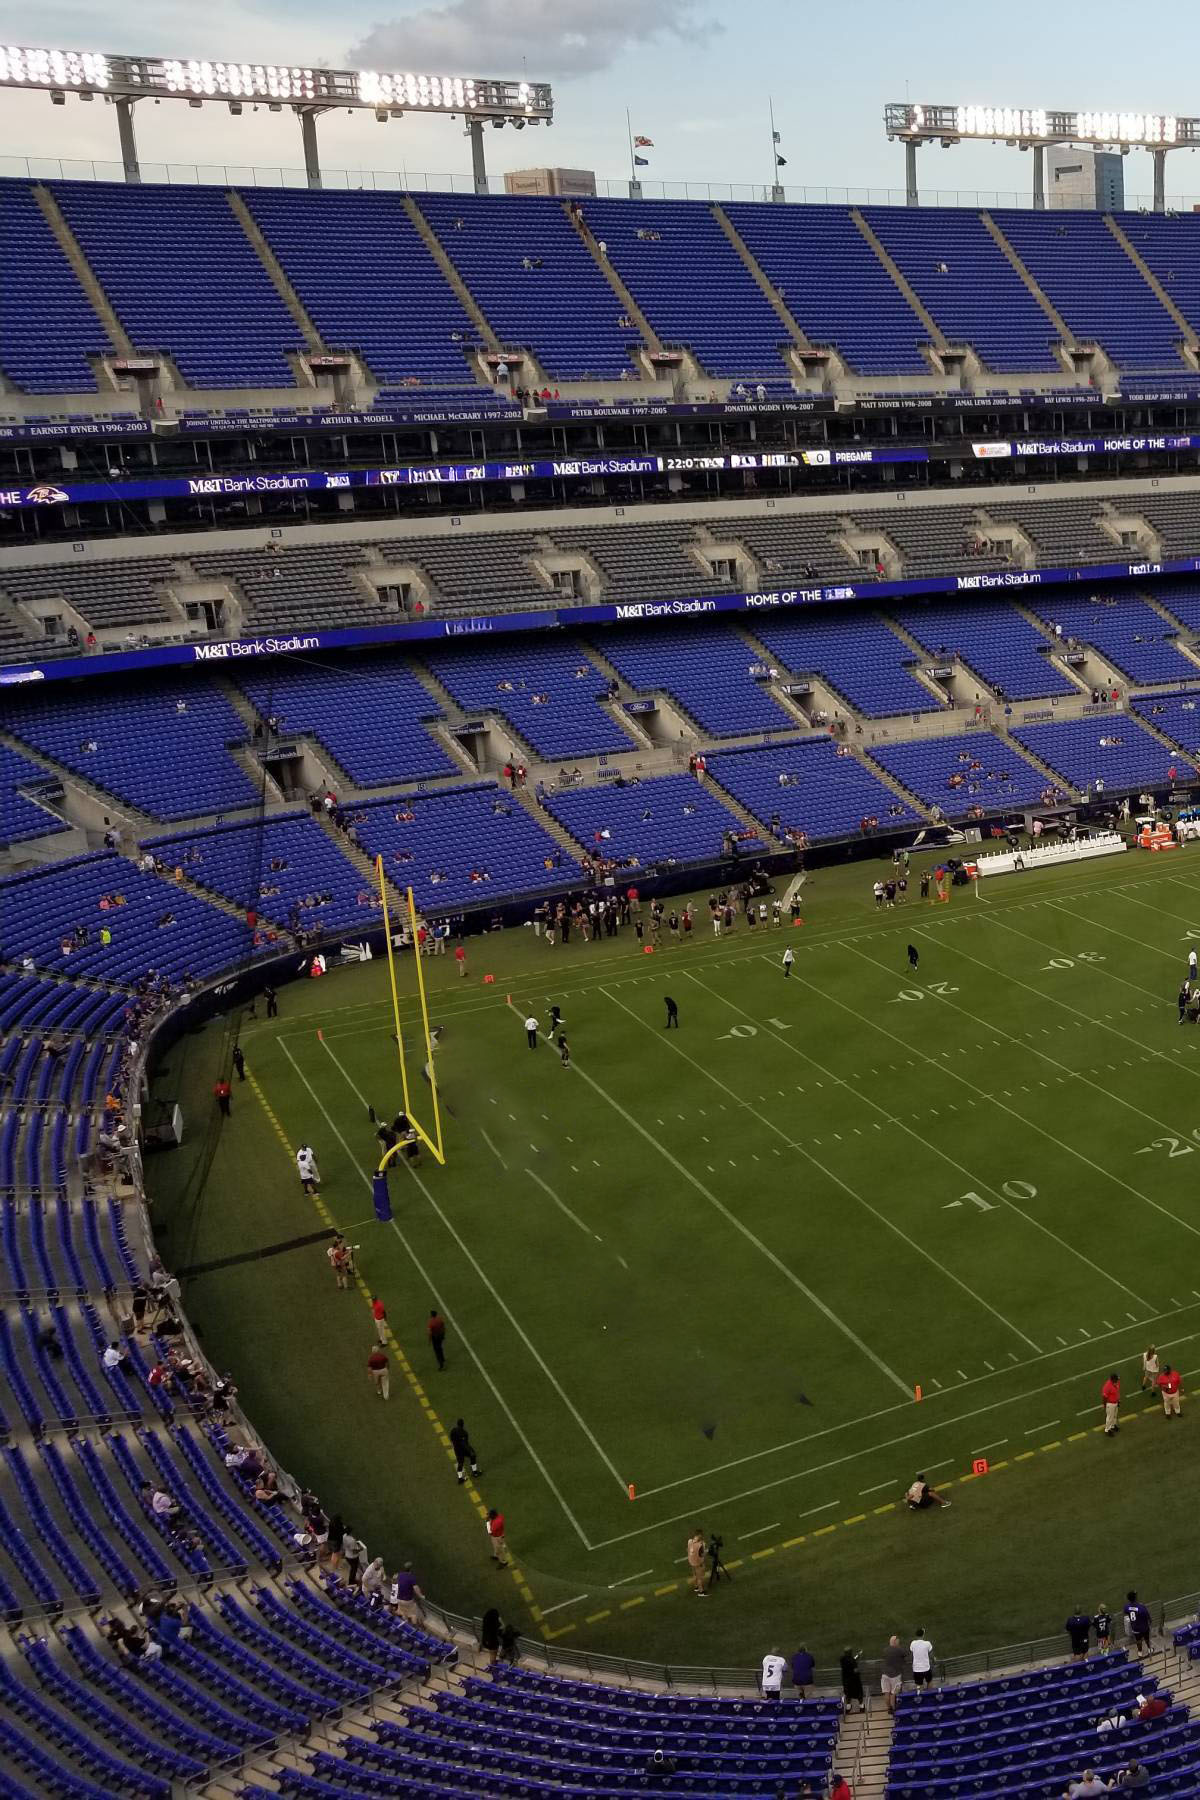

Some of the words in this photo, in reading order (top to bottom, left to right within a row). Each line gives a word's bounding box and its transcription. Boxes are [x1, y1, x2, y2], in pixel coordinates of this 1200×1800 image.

[724, 405, 757, 413] JONATHAN
[758, 404, 780, 412] OGDEN
[782, 403, 814, 411] 1996-2007
[955, 399, 974, 407] JAMAL
[414, 413, 446, 422] MICHAEL
[448, 411, 481, 420] McCRARY
[484, 411, 521, 419] 1997-2002
[571, 409, 593, 417] PETER
[594, 408, 630, 416] BOULWARE
[320, 416, 352, 425] ARTHUR
[364, 414, 394, 423] MODELL
[30, 427, 69, 436] EARNEST
[70, 425, 99, 434] BYNER
[101, 423, 147, 432] 1996-2003
[1016, 443, 1038, 455] M&T
[1039, 443, 1061, 454] Bank
[1061, 442, 1095, 453] Stadium
[1104, 440, 1131, 450] HOME
[1133, 439, 1145, 449] OF
[1148, 439, 1165, 449] THE
[816, 453, 824, 463] 0
[835, 451, 872, 462] PREGAME
[553, 462, 581, 475] M&T
[582, 462, 608, 474] Bank
[609, 460, 651, 472] Stadium
[189, 479, 223, 494] M&T
[224, 478, 255, 492] Bank
[256, 476, 308, 490] Stadium
[957, 576, 981, 589] M&T
[982, 575, 1005, 587] Bank
[1005, 573, 1040, 585] Stadium
[746, 594, 779, 607] HOME
[782, 592, 797, 603] OF
[800, 589, 821, 602] THE
[616, 604, 645, 619] M&T
[645, 602, 672, 615] Bank
[672, 600, 715, 613] Stadium
[193, 643, 231, 660] M&T
[231, 640, 265, 656] Bank
[265, 636, 319, 653] Stadium
[632, 703, 647, 711] Ford
[897, 981, 960, 1002] 20
[730, 1017, 793, 1038] 10
[961, 1180, 1038, 1214] 10
[976, 1462, 985, 1473] G
[767, 1665, 775, 1678] 5
